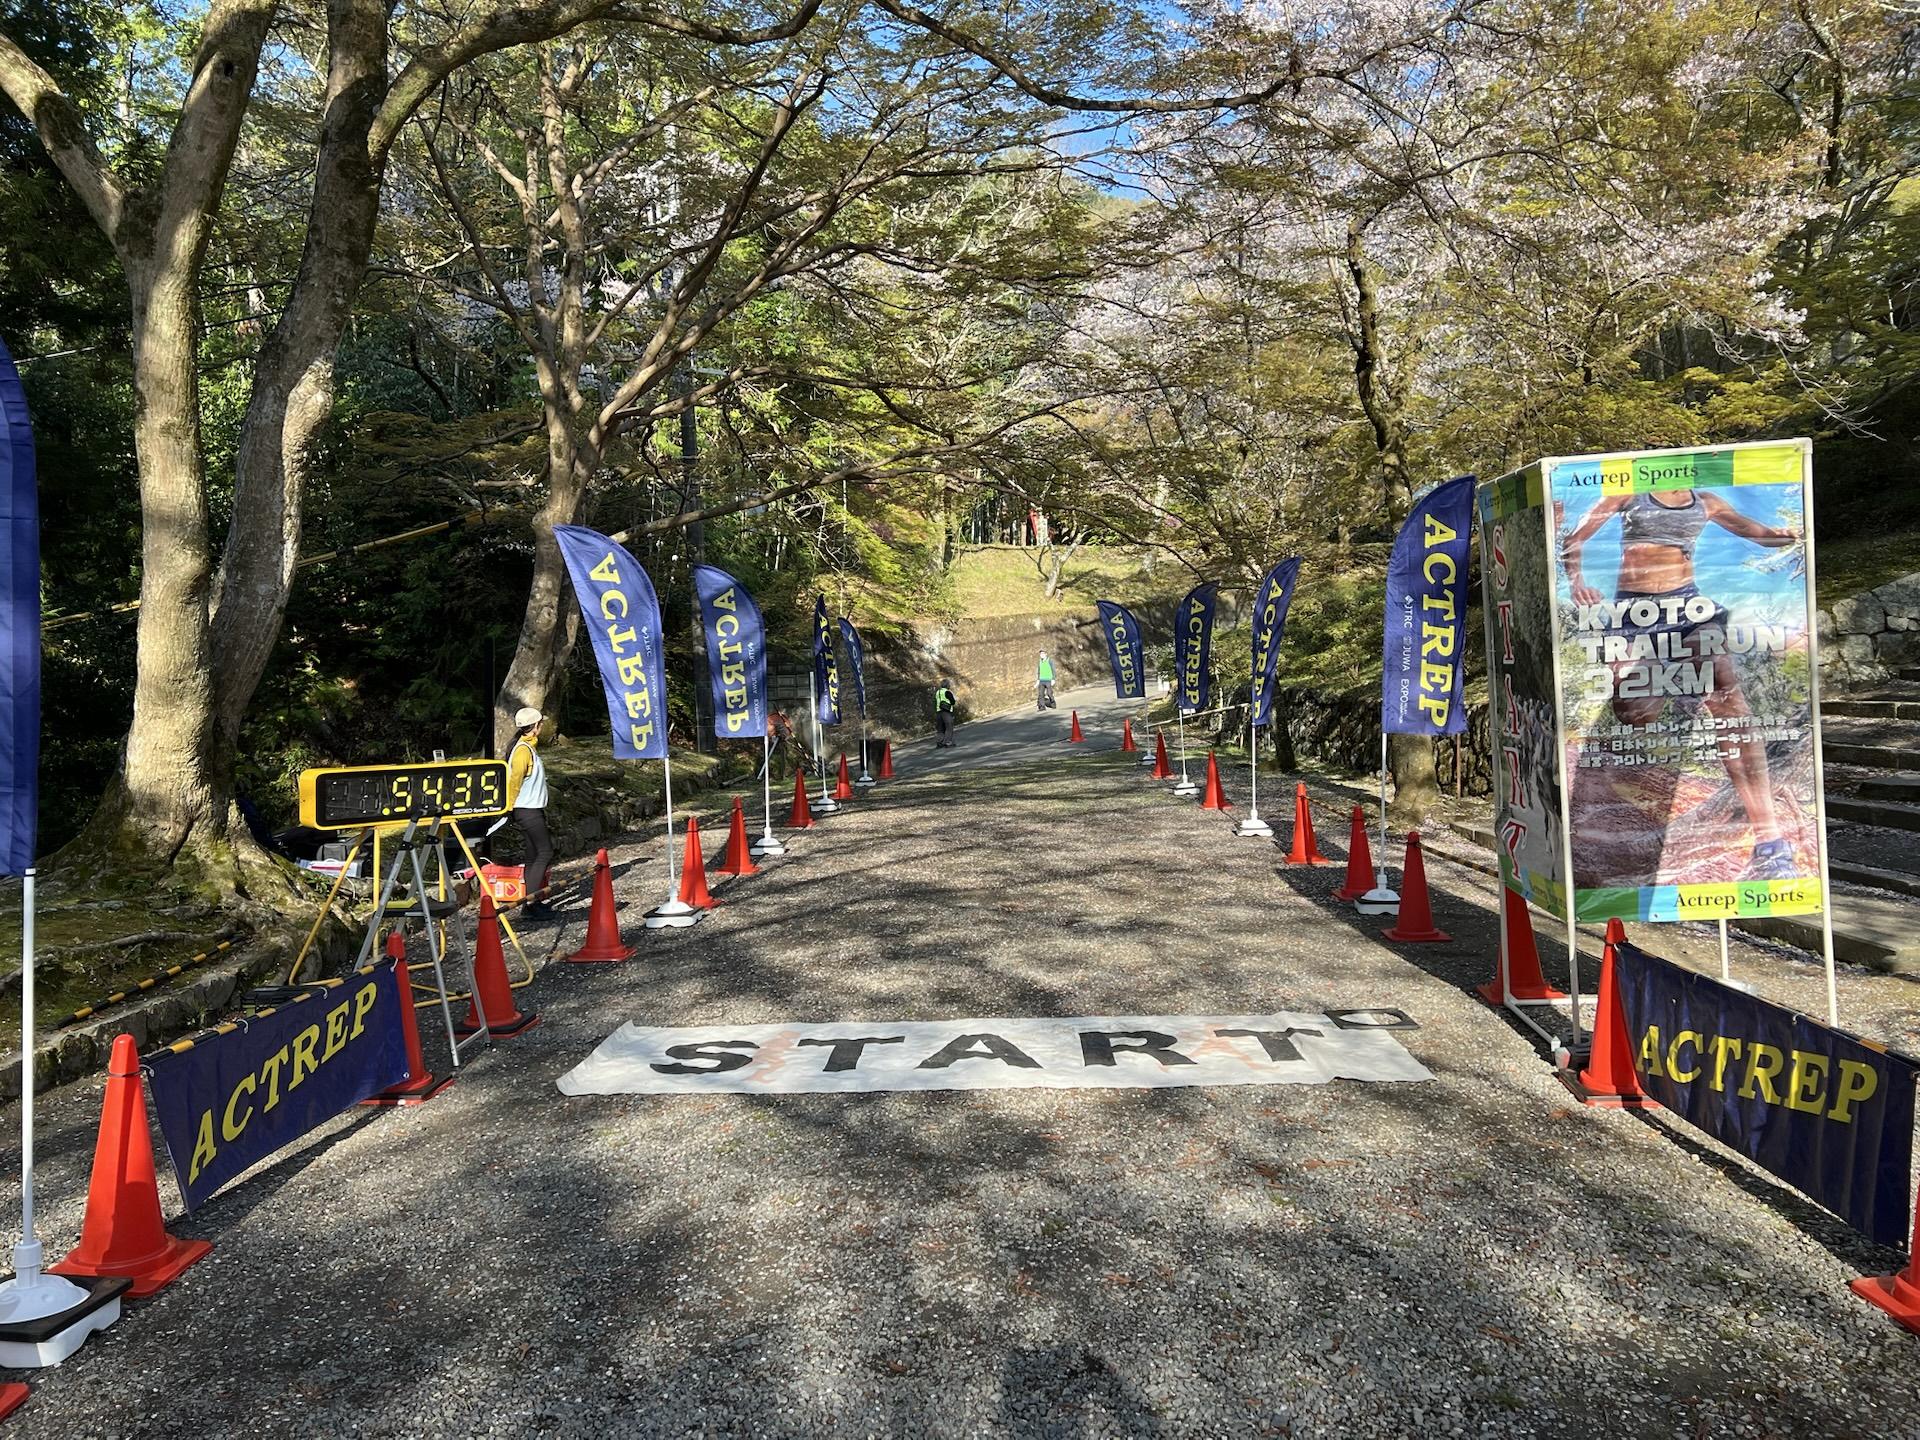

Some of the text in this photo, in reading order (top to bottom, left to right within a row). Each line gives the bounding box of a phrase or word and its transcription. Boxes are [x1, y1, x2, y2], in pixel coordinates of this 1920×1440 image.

[1569, 462, 1699, 488] Actrep Sports
[1403, 605, 1413, 629] JTRC
[1419, 513, 1457, 728] ACTREP
[1578, 596, 1716, 632] KYOTO
[1185, 597, 1206, 705] ACTREP
[1579, 625, 1788, 665] TRAIL RUN
[1583, 661, 1715, 701] 32KM
[1673, 888, 1805, 909] Actrep Sports
[649, 1027, 1325, 1075] START
[189, 981, 378, 1186] ACTREP
[1635, 1024, 1879, 1124] ACTREP
